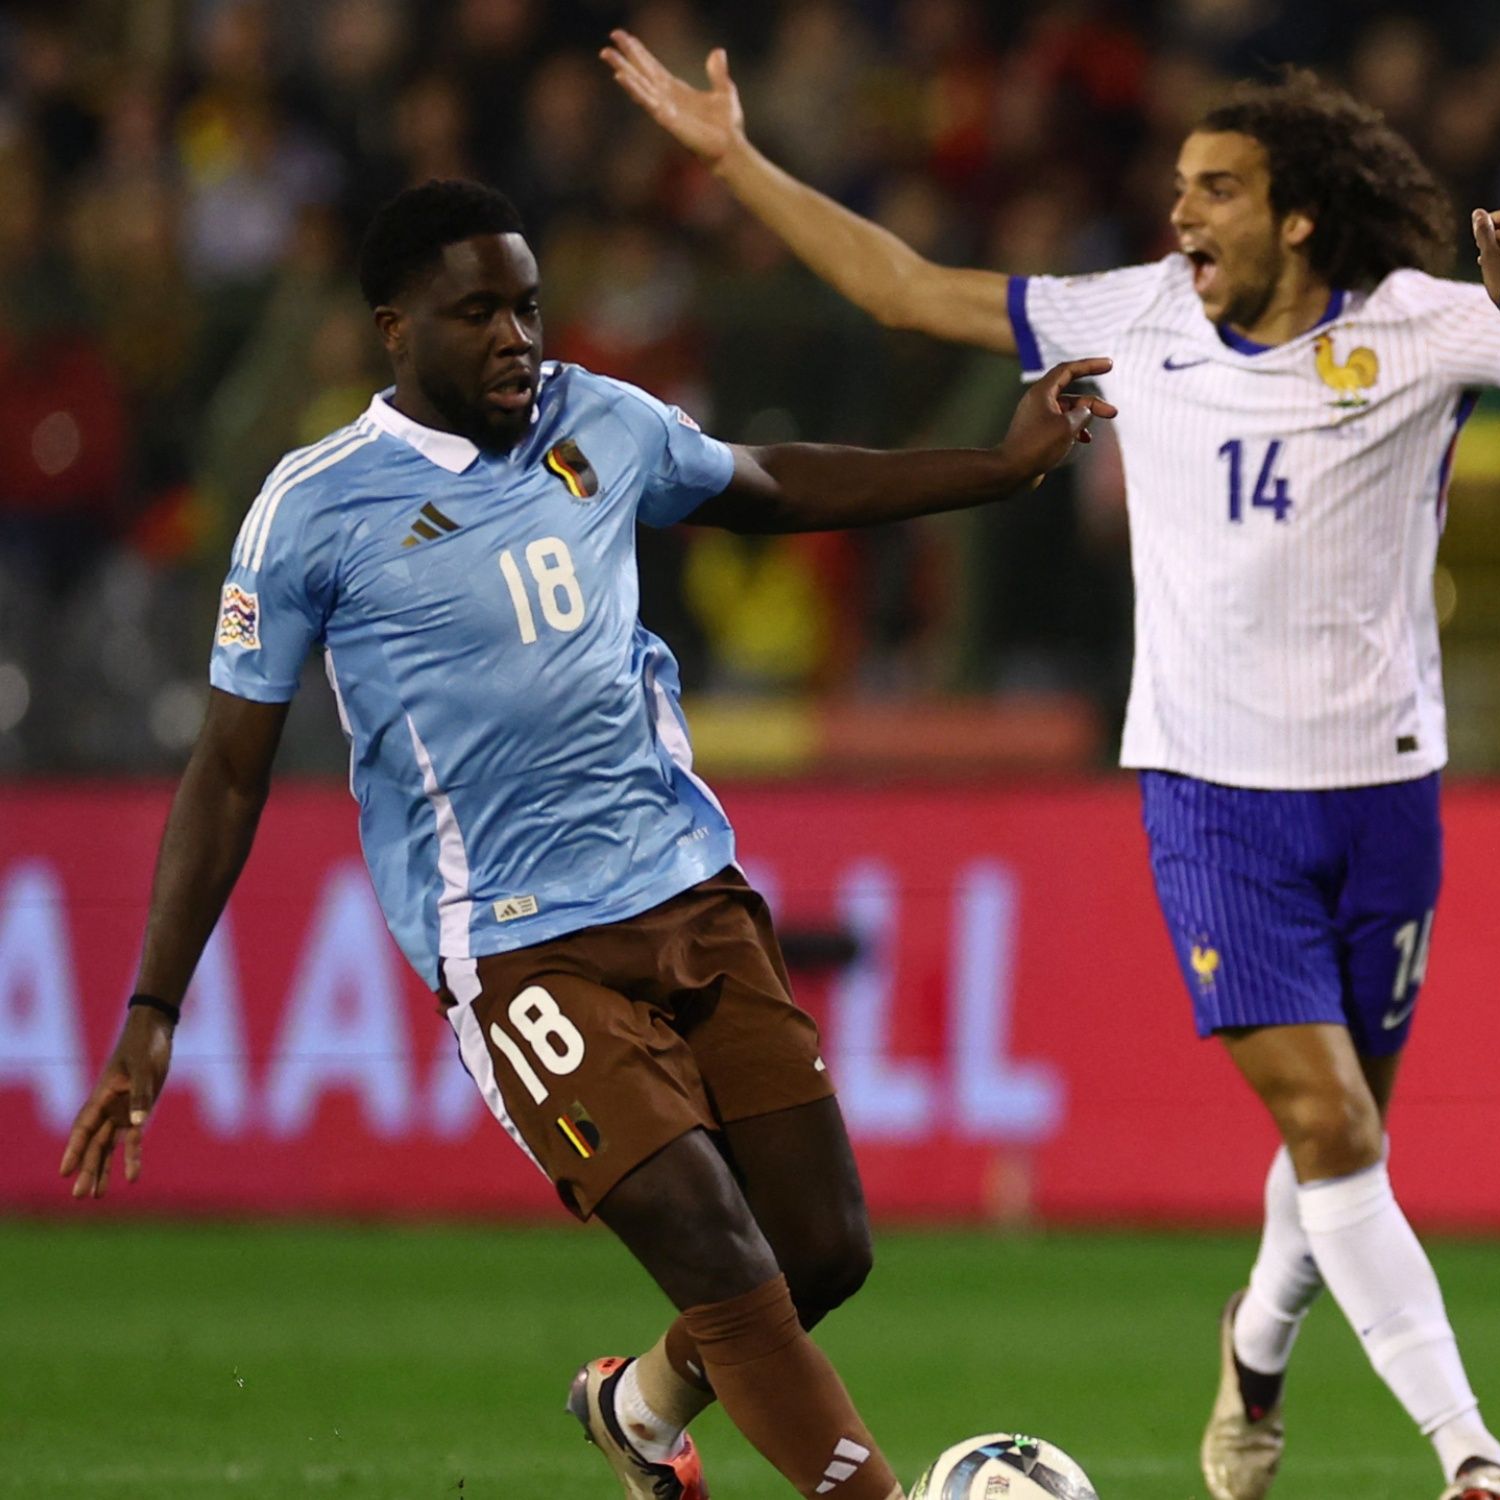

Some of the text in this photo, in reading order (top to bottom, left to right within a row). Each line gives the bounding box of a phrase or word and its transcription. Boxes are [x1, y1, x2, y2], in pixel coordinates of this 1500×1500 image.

[1218, 439, 1293, 523] 14
[498, 536, 585, 645] 18
[490, 985, 585, 1106] 18
